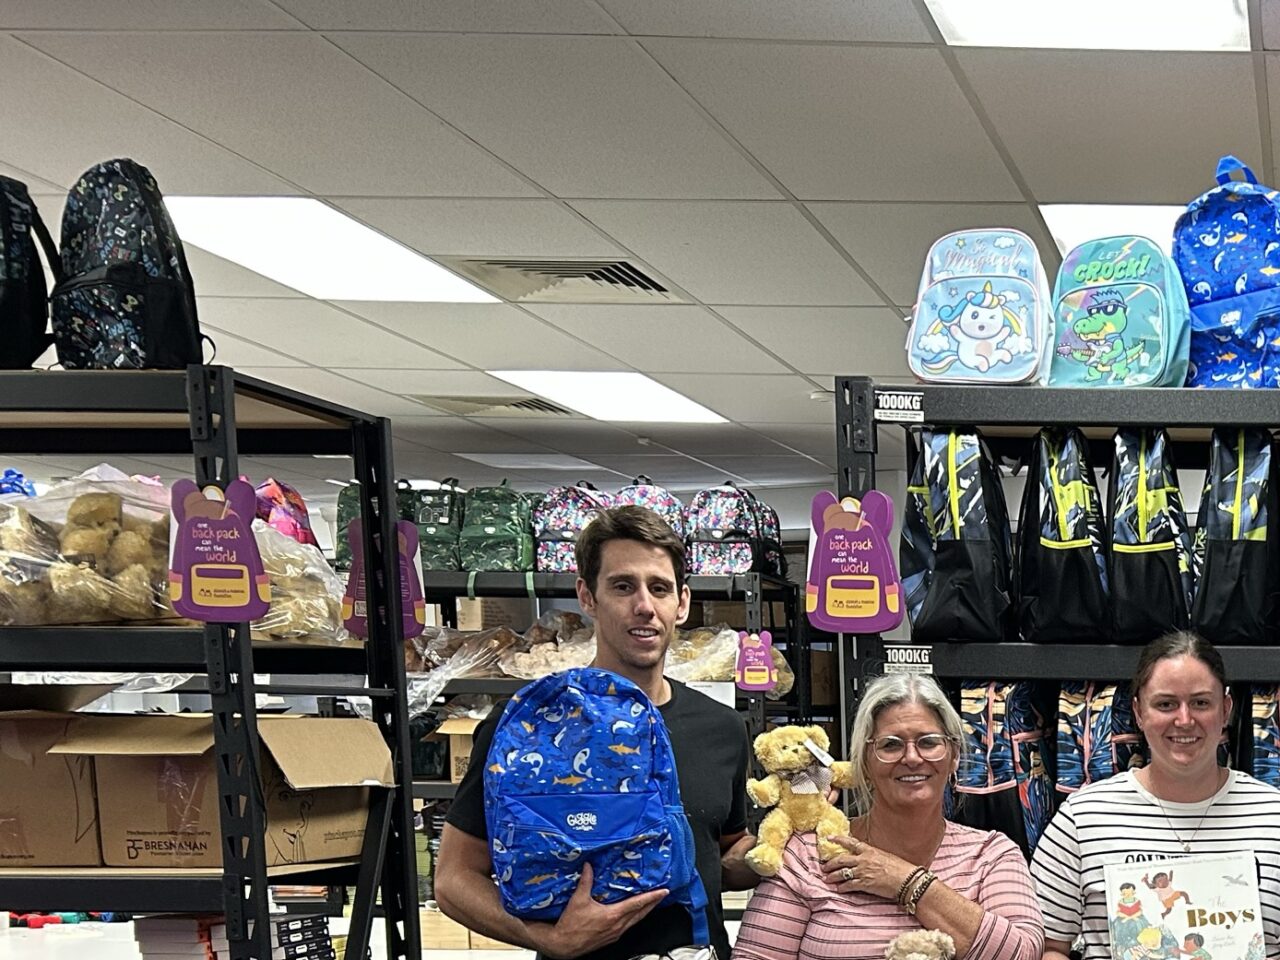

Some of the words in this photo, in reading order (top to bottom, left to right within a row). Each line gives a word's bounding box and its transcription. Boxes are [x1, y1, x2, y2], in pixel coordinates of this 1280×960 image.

[1072, 253, 1151, 283] CROCK!
[192, 528, 215, 539] back
[217, 527, 240, 542] pack
[829, 538, 850, 550] back
[851, 538, 873, 553] pack
[205, 550, 237, 562] world
[841, 561, 869, 574] world
[1186, 908, 1255, 930] Boys
